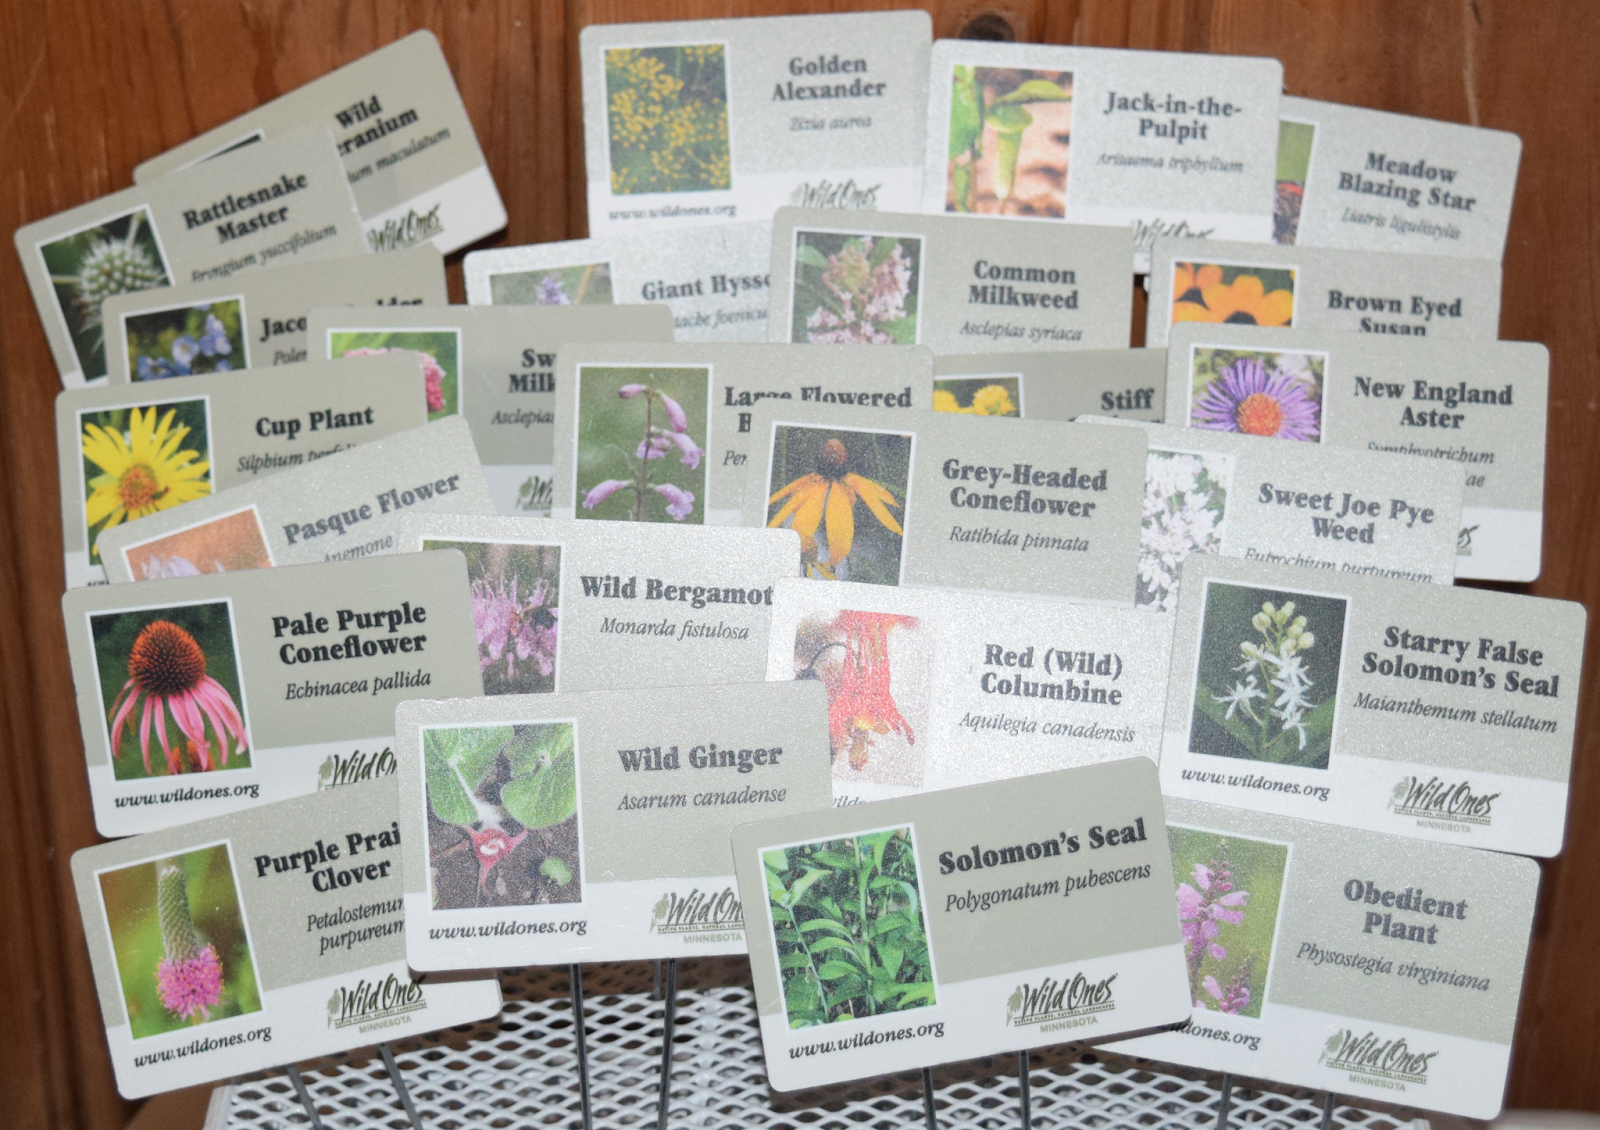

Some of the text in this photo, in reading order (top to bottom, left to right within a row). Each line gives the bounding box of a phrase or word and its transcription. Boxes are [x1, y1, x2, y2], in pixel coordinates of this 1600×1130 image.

[789, 57, 867, 77] Golden
[772, 79, 887, 101] Alexander
[1103, 92, 1243, 116] Jack-in-the-
[335, 94, 383, 129] Wild
[337, 108, 419, 158] eranium
[1138, 119, 1209, 144] Pulpit
[1364, 152, 1459, 185] Meadow
[183, 172, 309, 230] Rattlesnake
[1337, 172, 1477, 213] Blazing Star
[216, 206, 290, 245] Master
[608, 204, 737, 221] www.wildones.org
[641, 273, 771, 301] Giant Hyss
[973, 259, 1076, 285] Common
[967, 284, 1079, 310] Milkweed
[1327, 289, 1462, 321] Brown Eyed
[260, 316, 307, 343] Jaco
[959, 320, 1082, 342] Asclepias syriaca
[1359, 317, 1427, 337] Susan
[1100, 387, 1155, 411] Stiff
[1354, 376, 1513, 408] New England
[255, 405, 375, 441] Cup Plant
[1399, 405, 1465, 430] Aster
[236, 451, 303, 475] Silphium
[942, 458, 1108, 493] Grey-Headed
[283, 474, 460, 546] Pasque Flower
[950, 486, 1096, 518] Coneflower
[1257, 482, 1434, 529] Sweet Joe Pye
[949, 526, 1090, 553] Ratibida pinnata
[1312, 516, 1375, 545] Weed
[580, 575, 774, 609] Wild Bergamot
[272, 601, 427, 638] Pale Purple
[599, 617, 750, 641] Monarda fistulosa
[279, 632, 427, 666] Coneflower
[984, 644, 1123, 681] Red (Wild)
[1383, 626, 1544, 667] Starry False
[285, 669, 432, 701] Echinacea pallida
[980, 672, 1122, 707] Columbine
[1361, 652, 1560, 699] Solomon's Seal
[959, 711, 1136, 744] Aquilegia canadensis
[1353, 692, 1558, 735] Maianthemum stellatum
[333, 750, 378, 787] Wild
[617, 743, 783, 774] Wild Ginger
[114, 783, 260, 808] www.wildones.org
[617, 786, 787, 812] Asarum canadense
[1181, 768, 1331, 802] www.wildones.org
[1403, 776, 1455, 812] Wild
[1447, 781, 1499, 818] Ones
[254, 821, 401, 878] Purple Prai
[939, 817, 1148, 876] Solomon's Seal
[312, 860, 391, 893] Clover
[945, 864, 1152, 913] Polygonatum pubescens
[666, 886, 744, 928] Wild On
[1343, 879, 1469, 920] Obedient
[429, 919, 588, 940] www.wildones.org
[682, 932, 743, 944] MINNESOTA
[1362, 910, 1440, 945] Plant
[1296, 942, 1490, 992] Physostegia virginiana
[340, 973, 427, 1021] Wild Ones
[1021, 971, 1117, 1020] Wild Ones
[359, 1015, 413, 1034] MINNESOTA
[788, 1019, 946, 1060] www.wildones.org
[1040, 1015, 1099, 1034] MINNESOTA
[1184, 1020, 1262, 1052] dones.org
[134, 1025, 273, 1068] www.wildones.org
[1335, 1029, 1440, 1075] Wild Ones
[1348, 1072, 1407, 1092] MINNESOTA
